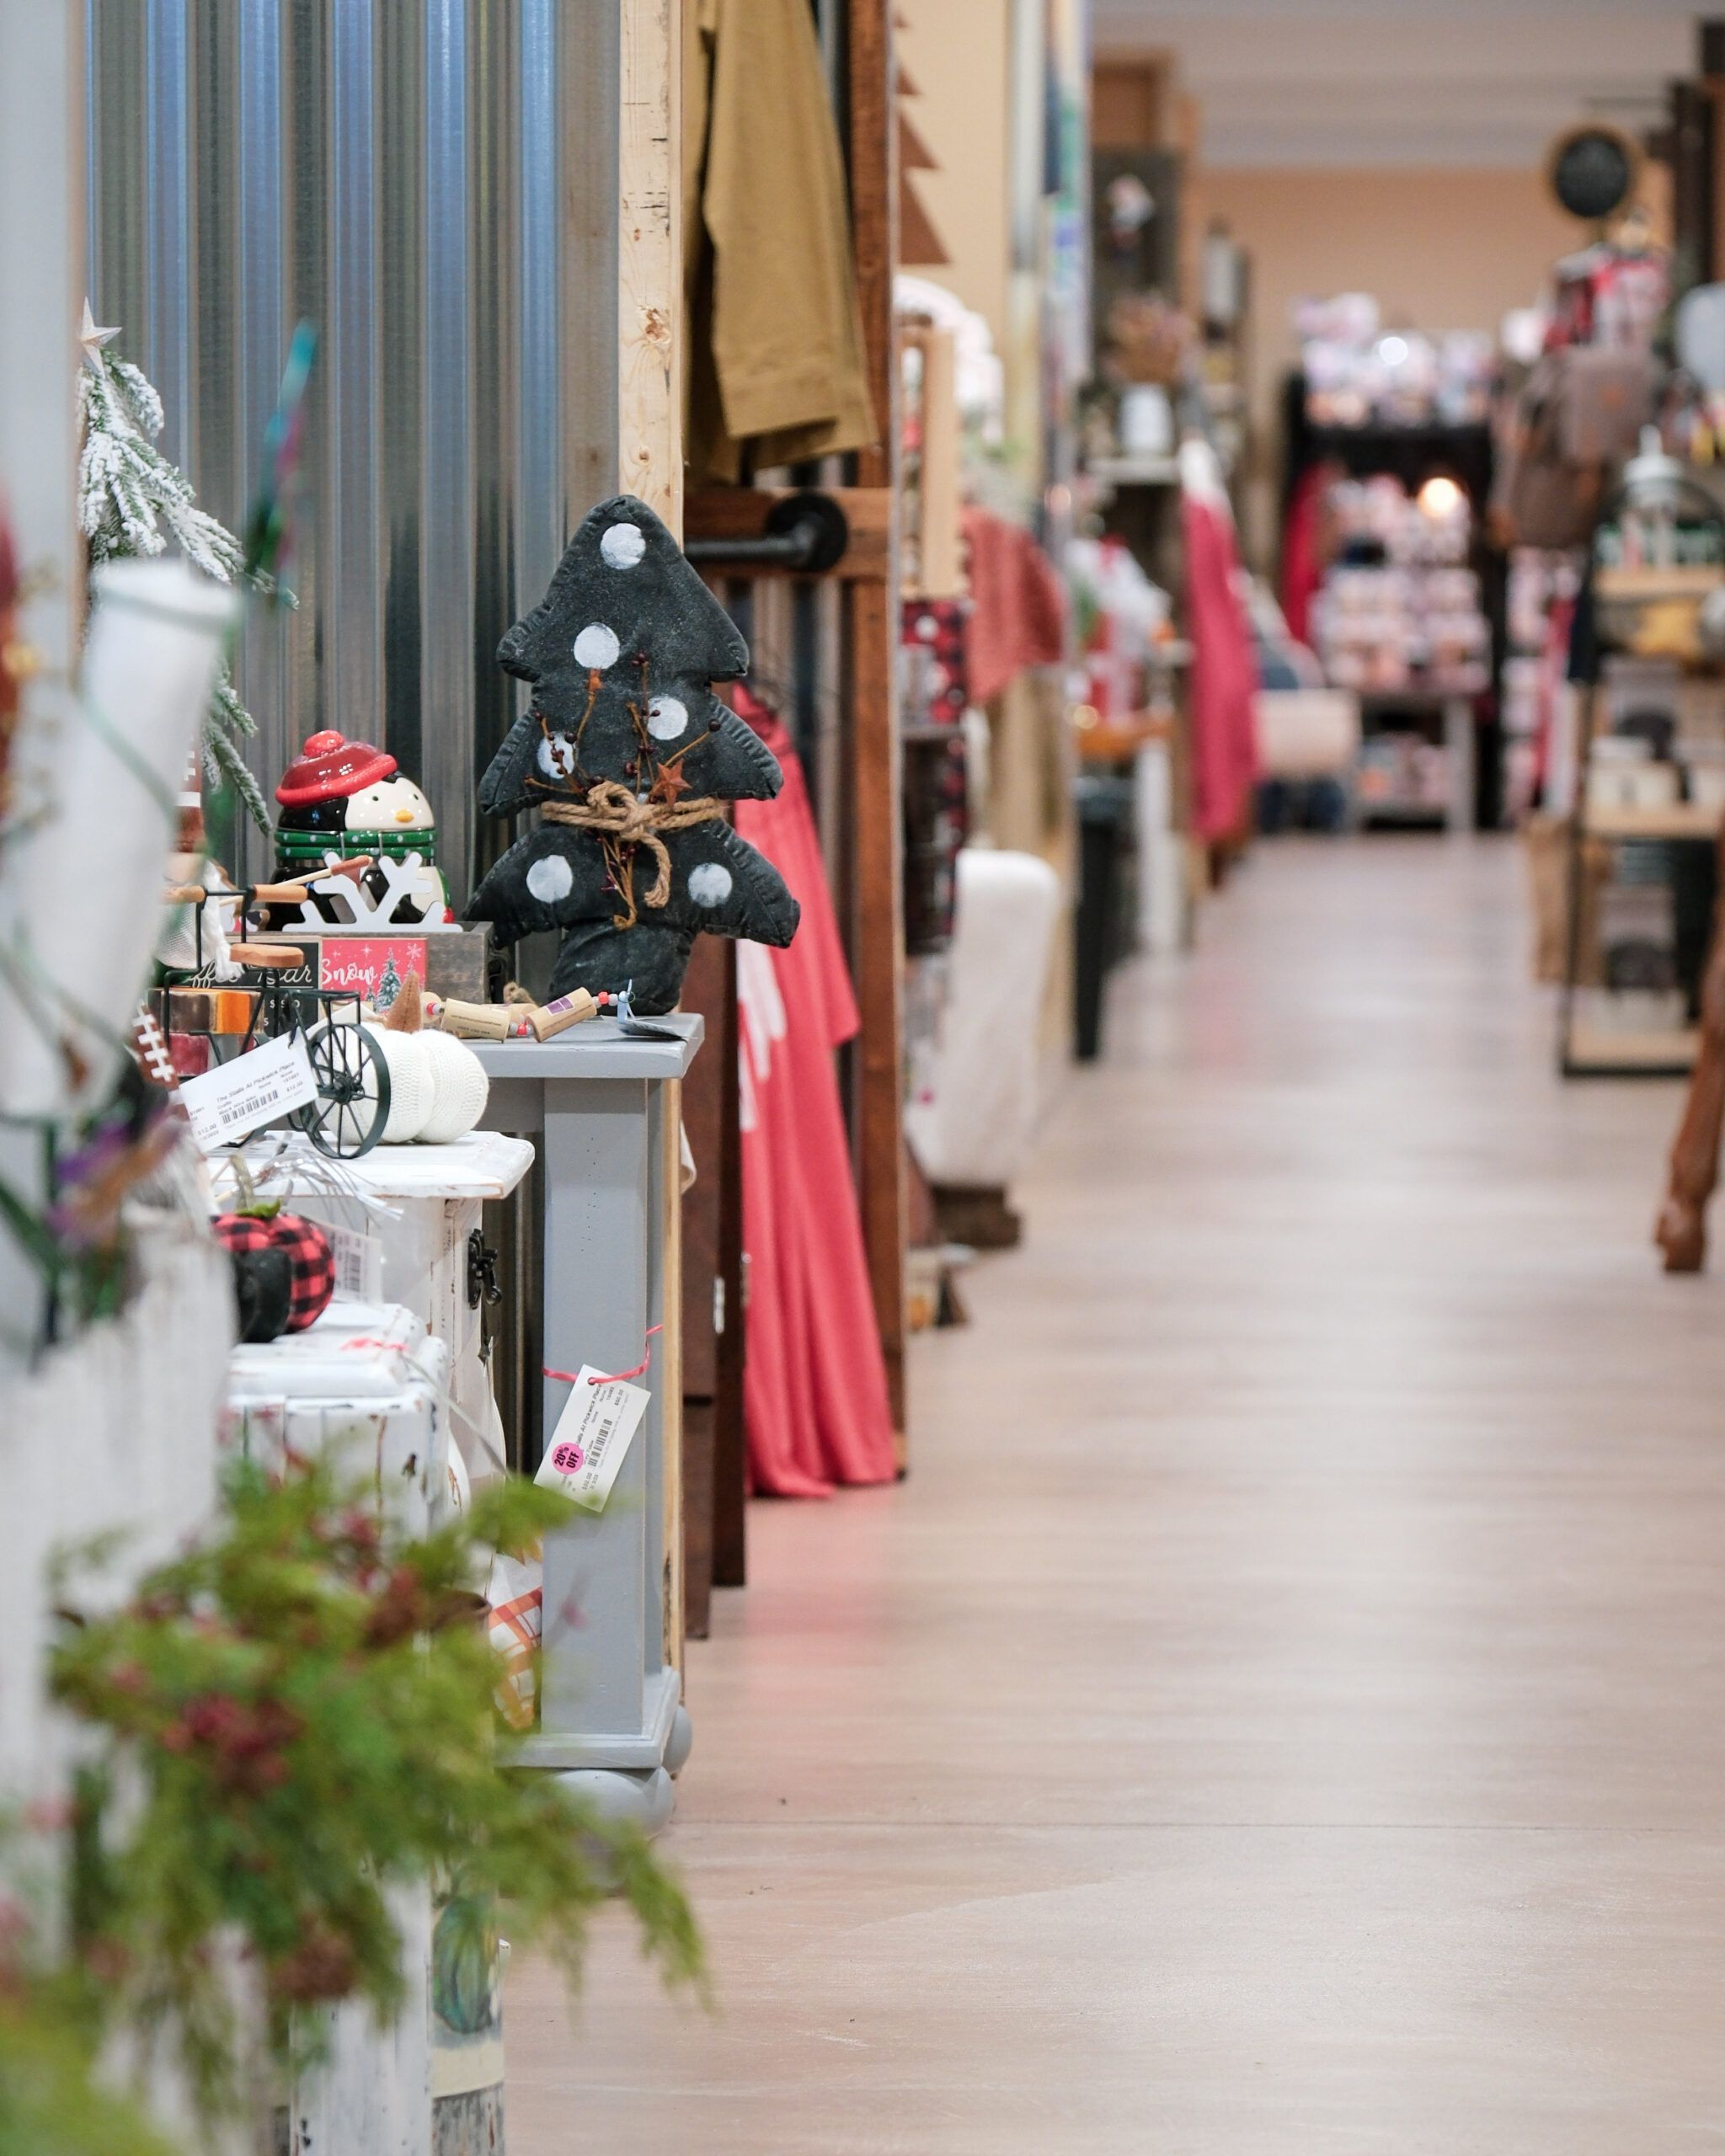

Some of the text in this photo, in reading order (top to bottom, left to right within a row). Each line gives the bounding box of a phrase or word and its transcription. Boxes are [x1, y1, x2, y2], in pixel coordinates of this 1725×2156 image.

[322, 958, 378, 985] Snow
[554, 1447, 569, 1466] 20%
[566, 1451, 579, 1468] OFF
